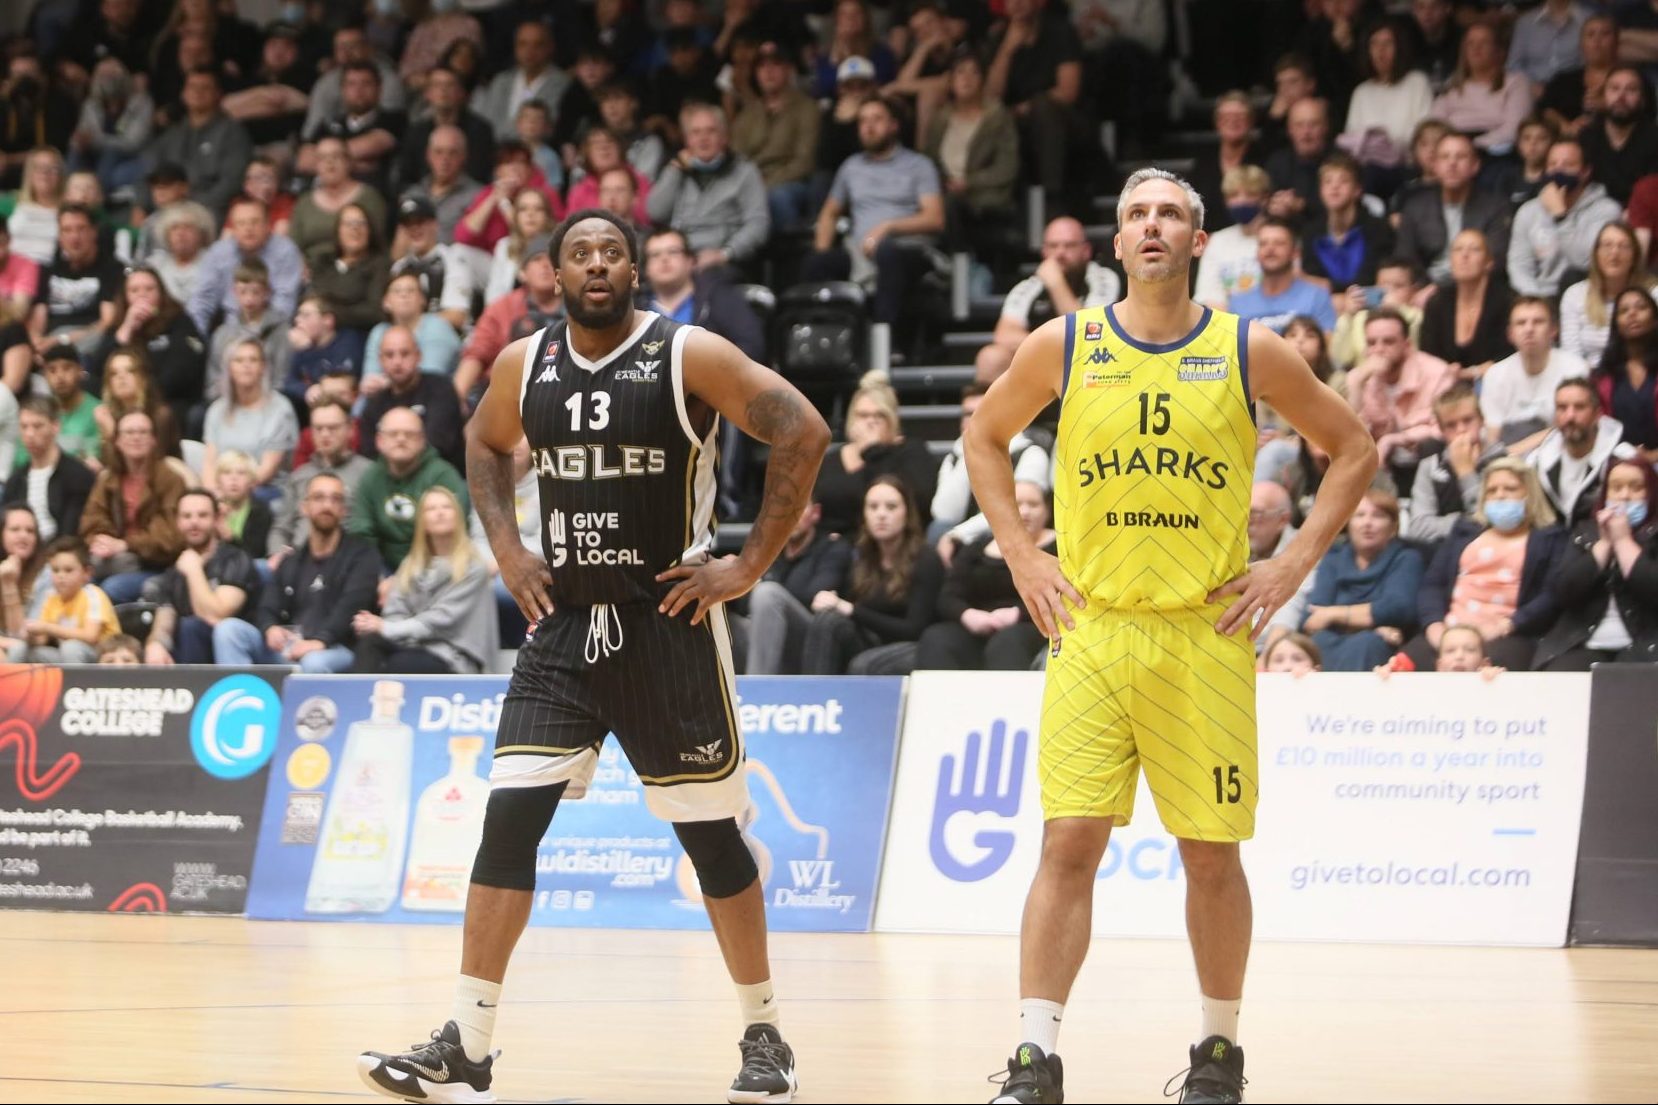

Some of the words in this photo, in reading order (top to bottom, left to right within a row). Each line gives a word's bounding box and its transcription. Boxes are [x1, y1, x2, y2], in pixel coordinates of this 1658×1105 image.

[615, 372, 658, 380] EAGLES
[564, 391, 612, 432] 13
[1138, 392, 1171, 435] 15
[1079, 447, 1229, 490] SHARKS
[572, 512, 619, 529] GIVE
[1106, 511, 1119, 527] B
[1124, 512, 1199, 529] BRAUN
[573, 531, 601, 547] TO
[576, 549, 644, 565] LOCAL
[64, 687, 194, 714] GATESHEAD
[61, 711, 163, 736] COLLEGE
[1306, 713, 1375, 736] We're
[1381, 714, 1467, 740] aiming
[1473, 714, 1498, 736] to
[1504, 716, 1548, 740] put
[1275, 747, 1317, 767] £10
[1323, 748, 1402, 768] million
[1409, 752, 1427, 768] a
[1432, 752, 1489, 772] year
[1495, 748, 1544, 768] into
[1212, 765, 1242, 804] 15
[1334, 782, 1470, 805] community
[1476, 782, 1541, 804] sport
[53, 809, 103, 830] College
[104, 809, 175, 827] Basketball
[788, 860, 841, 888] WL
[1288, 860, 1532, 890] givetolocal.com
[774, 888, 856, 914] Distillery
